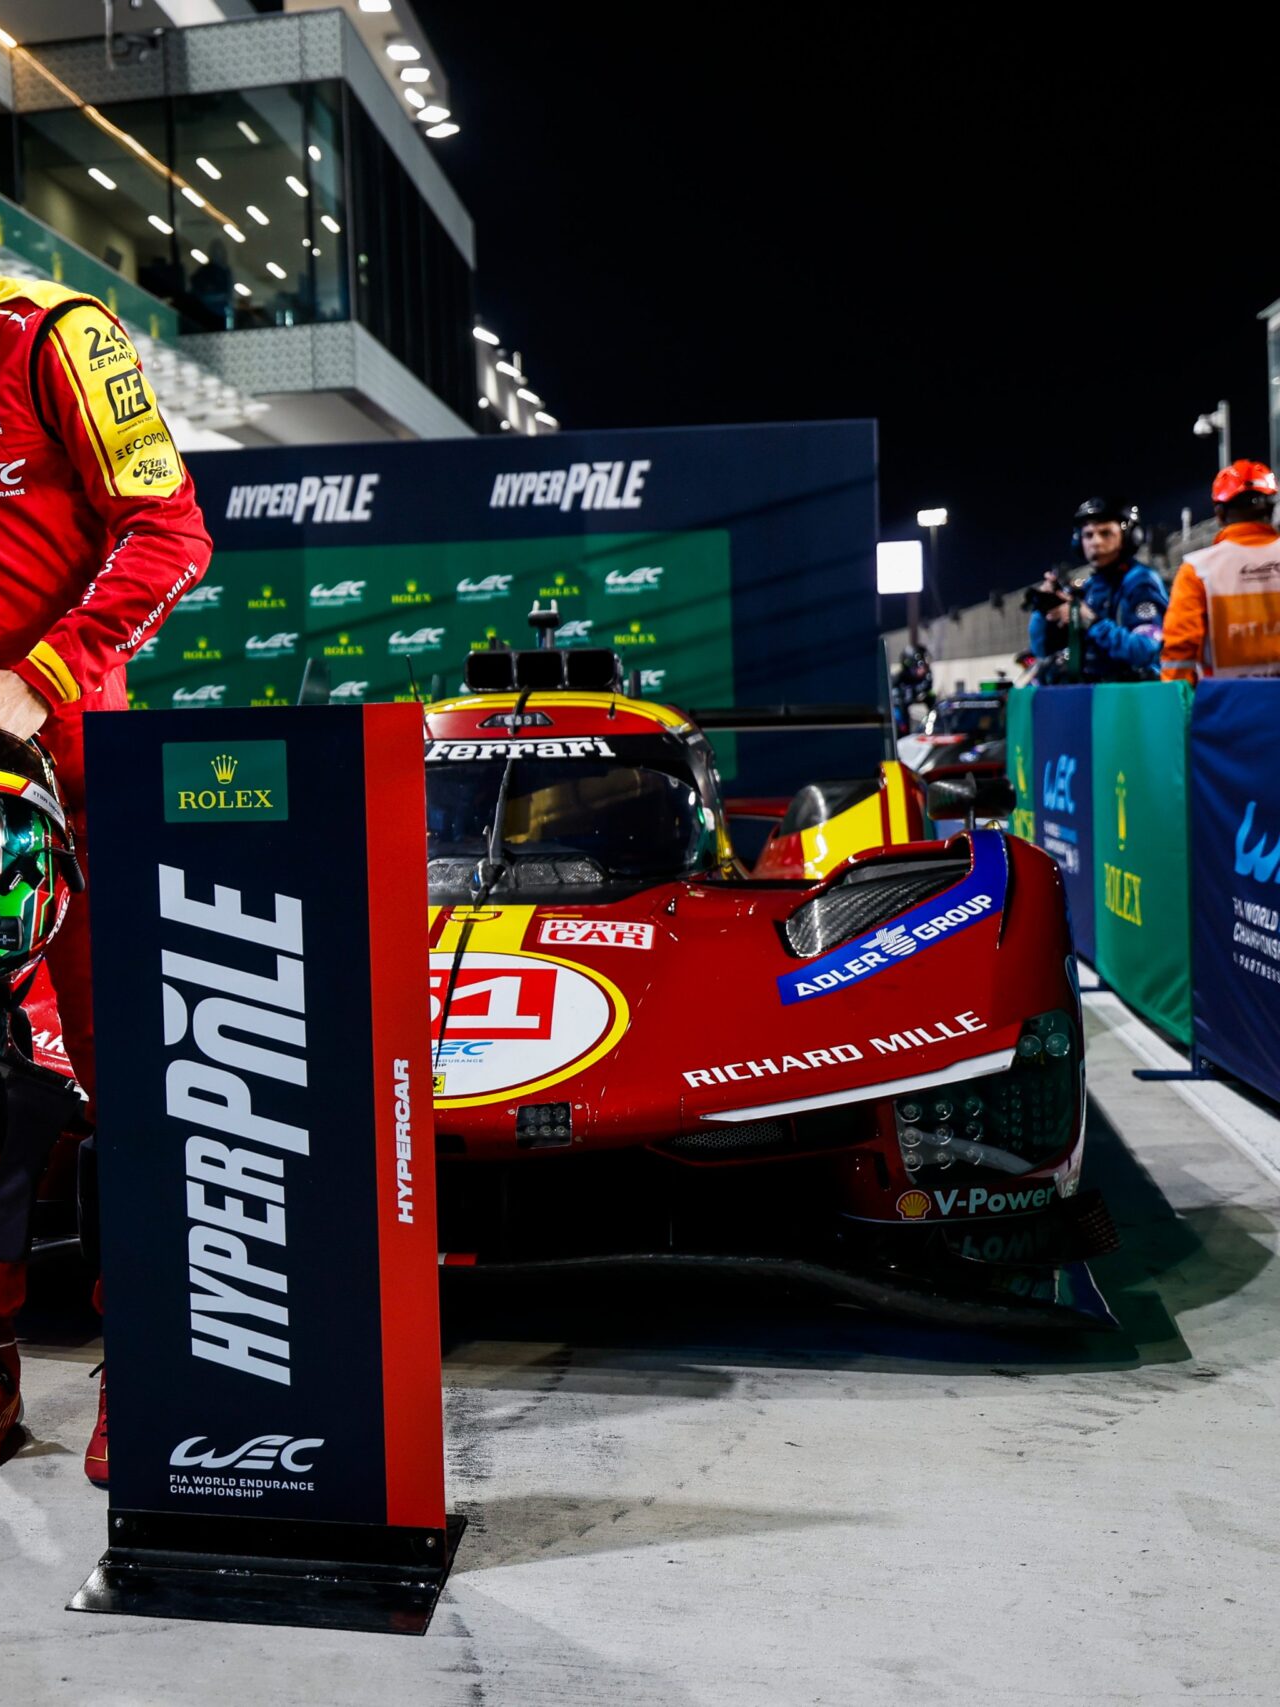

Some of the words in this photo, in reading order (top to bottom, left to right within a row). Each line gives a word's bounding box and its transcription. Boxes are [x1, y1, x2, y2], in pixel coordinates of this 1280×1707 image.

[90, 358, 105, 372] LE
[125, 431, 169, 455] ECOPOL
[166, 562, 198, 602] MILLE
[457, 574, 513, 592] WEC
[605, 567, 664, 585] WEC
[309, 580, 366, 598] WEC
[391, 593, 431, 603] ROLEX
[539, 586, 580, 597] ROLEX
[245, 633, 299, 650] WEC
[389, 627, 445, 645] WEC
[614, 634, 656, 644] ROLEX
[323, 646, 364, 656] ROLEX
[173, 685, 226, 701] WEC
[424, 737, 616, 762] Ferrari
[178, 789, 274, 810] ROLEX
[1104, 863, 1142, 927] ROLEX
[1244, 901, 1279, 931] WORLD
[550, 922, 646, 933] HYPER
[548, 929, 644, 946] CAR
[794, 951, 889, 997] ADLER
[912, 894, 992, 941] GROUP
[432, 1041, 494, 1056] EC
[682, 1043, 864, 1088] RICHARD
[869, 1010, 988, 1055] MILLE
[393, 1058, 414, 1224] HYPERCAR
[933, 1186, 1057, 1216] V-Power
[169, 1434, 325, 1473] WEC
[169, 1474, 189, 1484] FIA
[192, 1475, 237, 1487] WORLD
[239, 1478, 315, 1491] ENDURANCE
[170, 1485, 264, 1498] CHAMPIONSHIP
